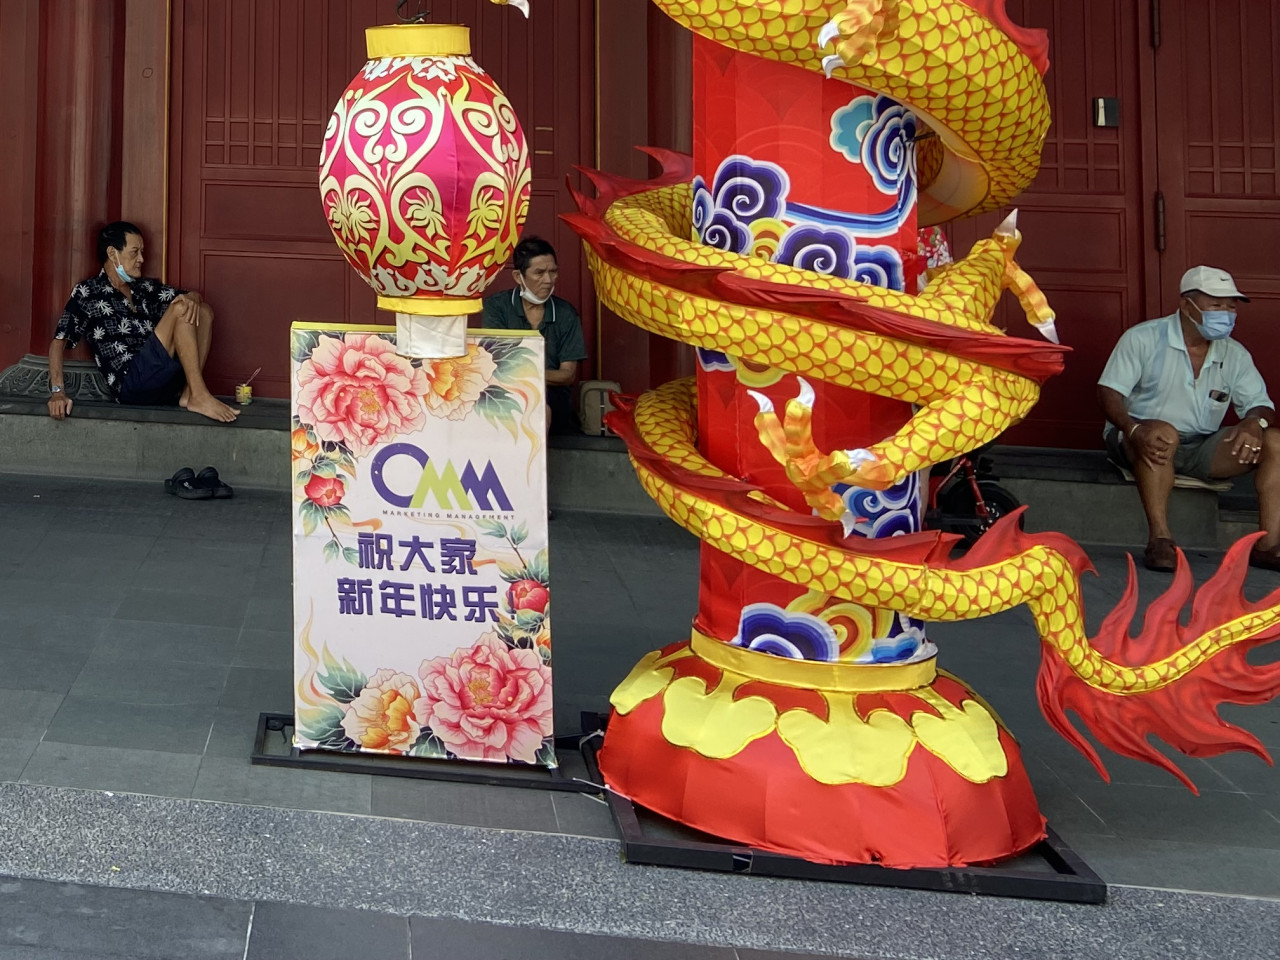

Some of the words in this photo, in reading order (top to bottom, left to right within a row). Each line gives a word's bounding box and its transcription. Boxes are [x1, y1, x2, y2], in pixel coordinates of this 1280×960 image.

[382, 509, 441, 519] MARKETING
[446, 513, 515, 521] MANAGEMENT
[357, 531, 478, 576] 祝大家
